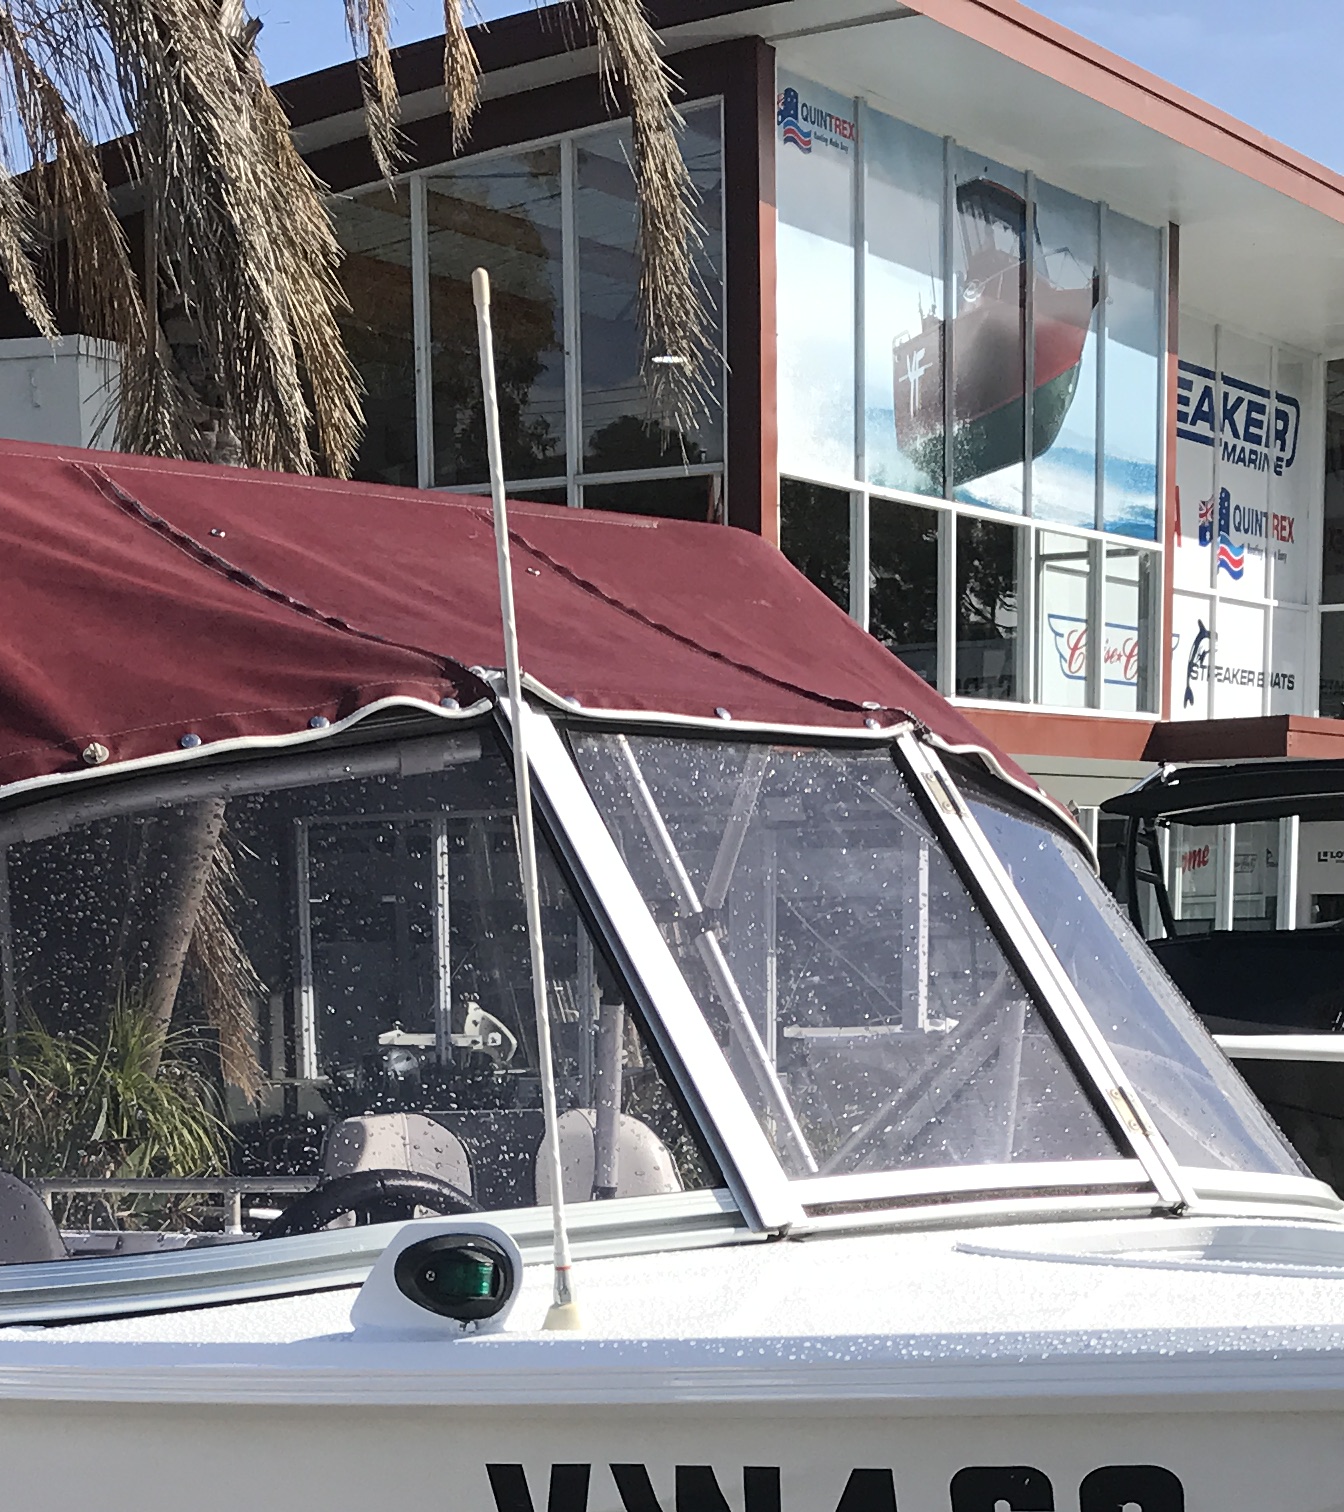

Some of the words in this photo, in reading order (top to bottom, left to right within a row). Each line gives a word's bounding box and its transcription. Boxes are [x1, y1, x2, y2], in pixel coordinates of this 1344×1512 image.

[801, 102, 855, 142] QUINTREX
[1177, 376, 1290, 452] EAKER
[1257, 671, 1296, 692] BATS
